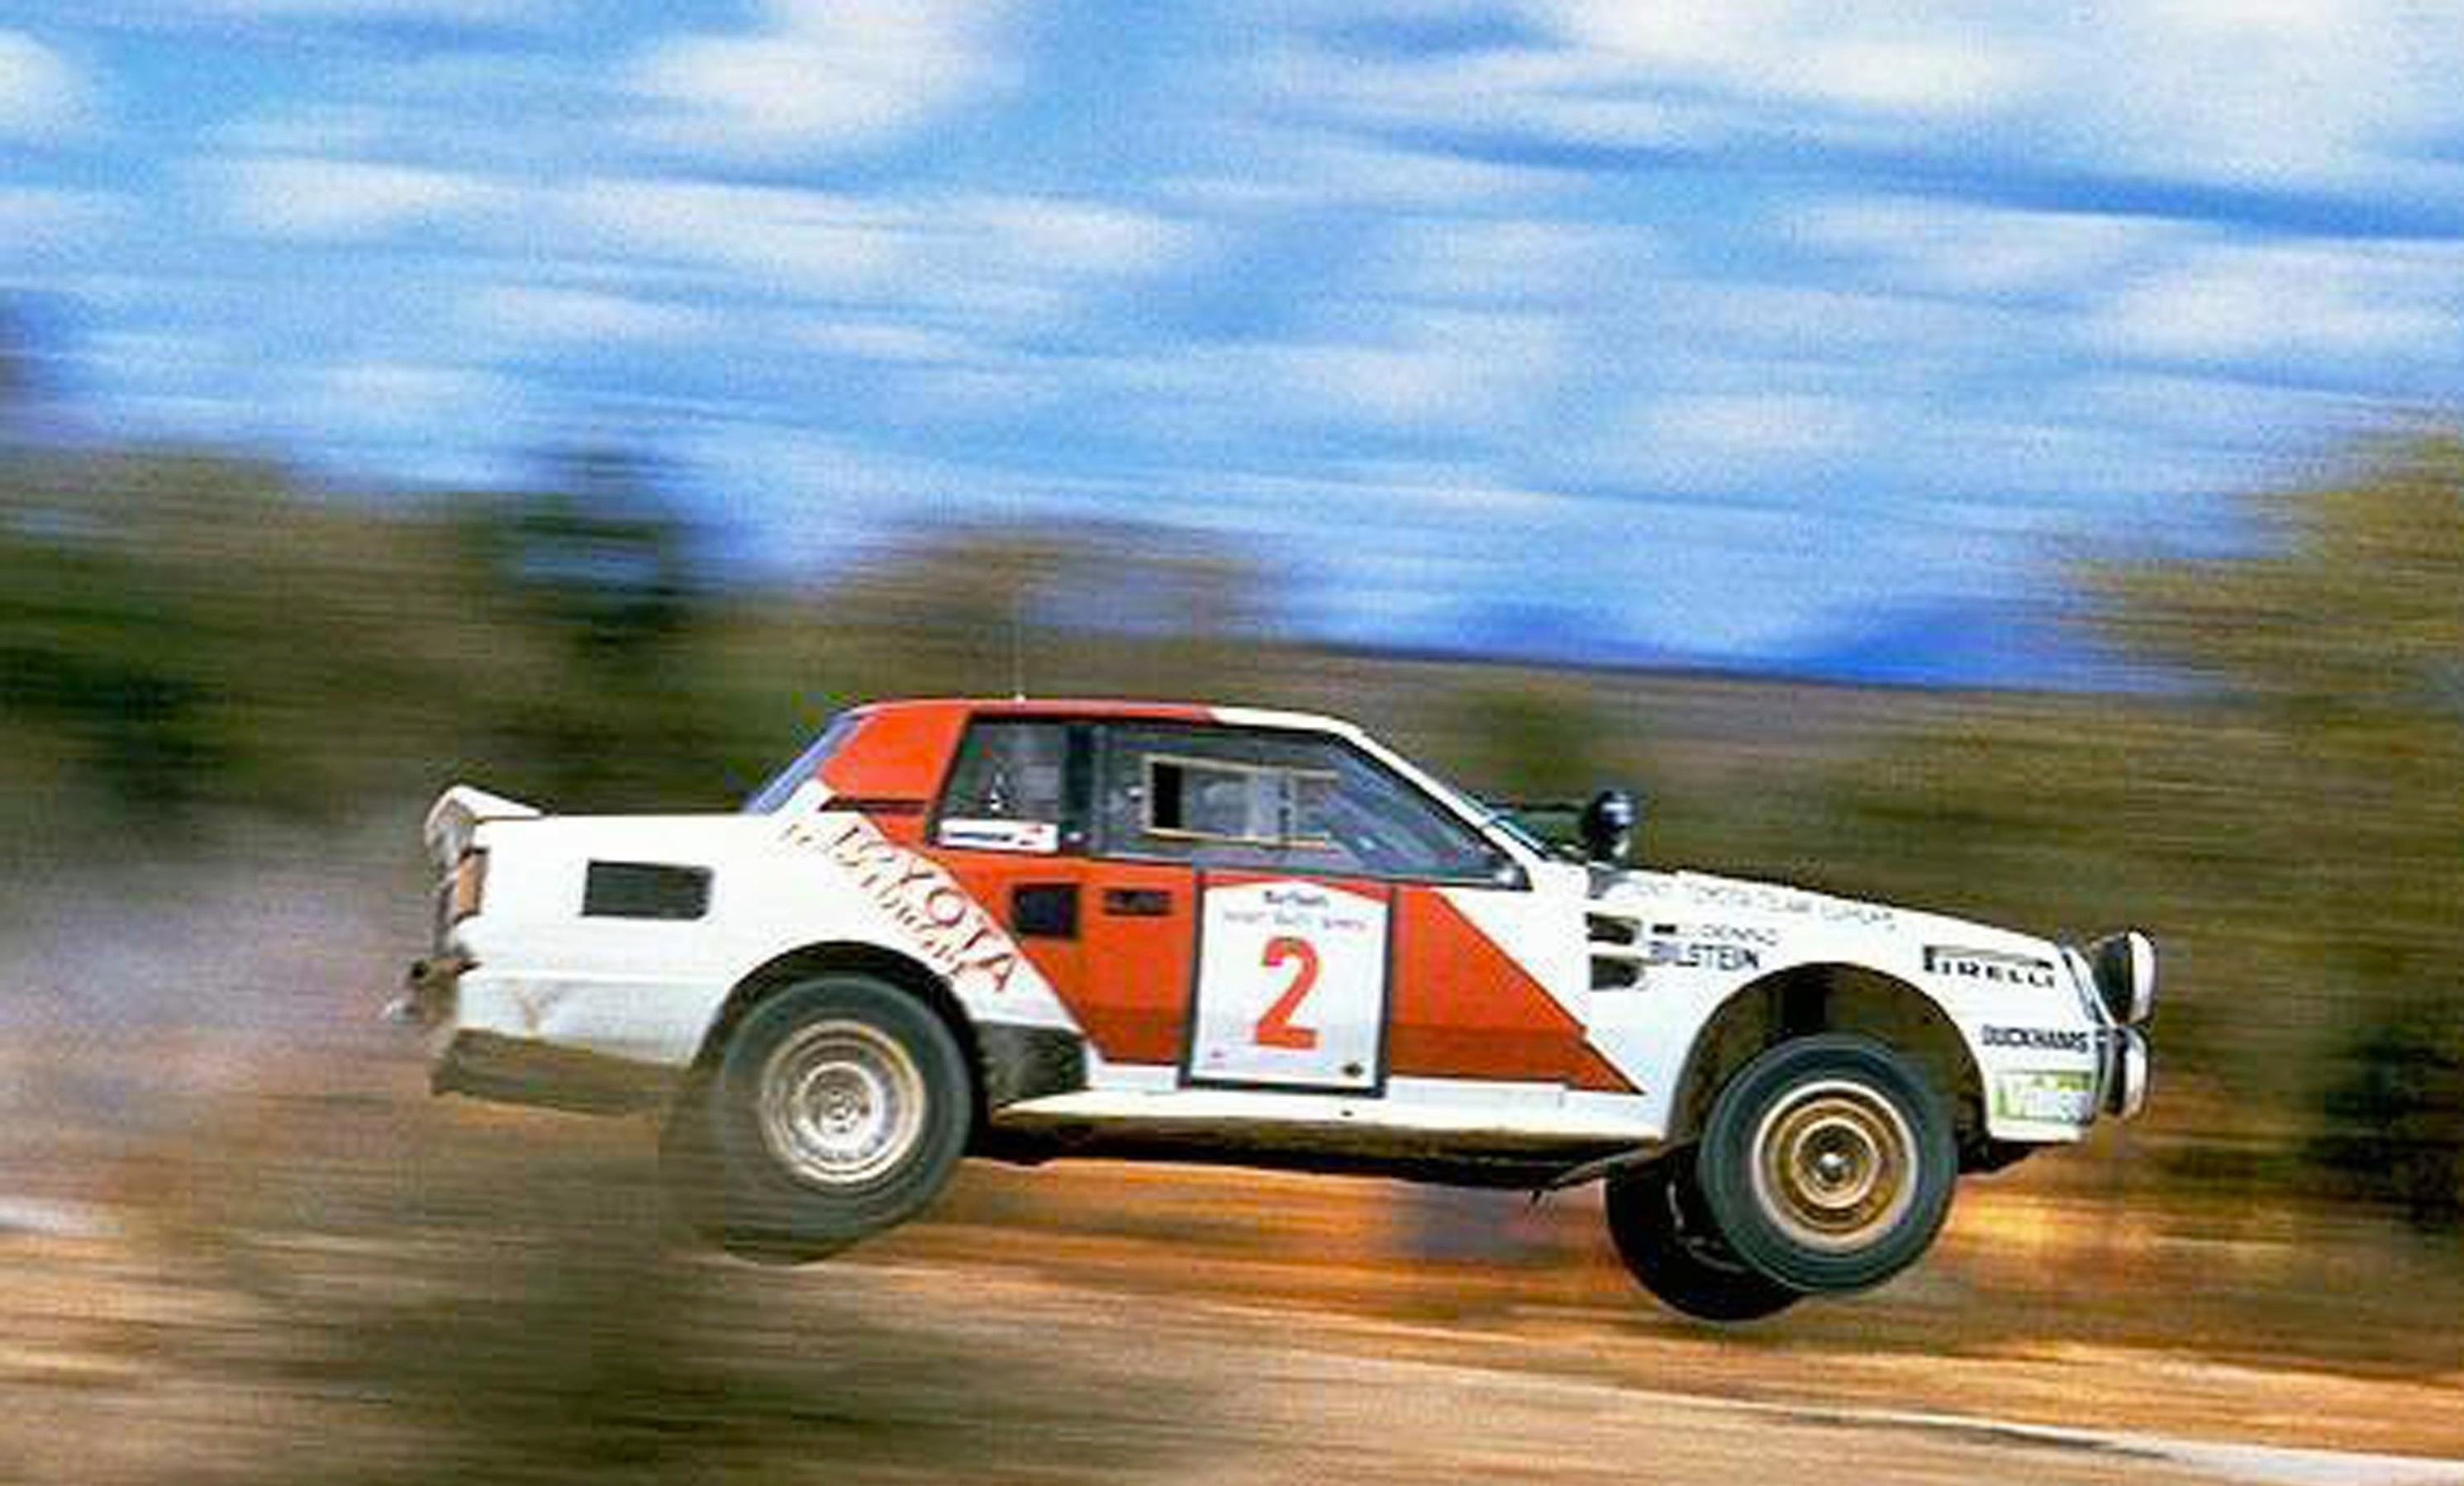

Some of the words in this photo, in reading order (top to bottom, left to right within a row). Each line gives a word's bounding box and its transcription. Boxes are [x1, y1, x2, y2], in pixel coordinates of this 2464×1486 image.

[830, 816, 1017, 992] TOYOTA
[1650, 941, 1760, 970] BILSTEIN
[1924, 946, 2056, 988] PIRELLI
[1255, 936, 1320, 1050] 2
[1982, 1024, 2088, 1053] DUCKHAMS
